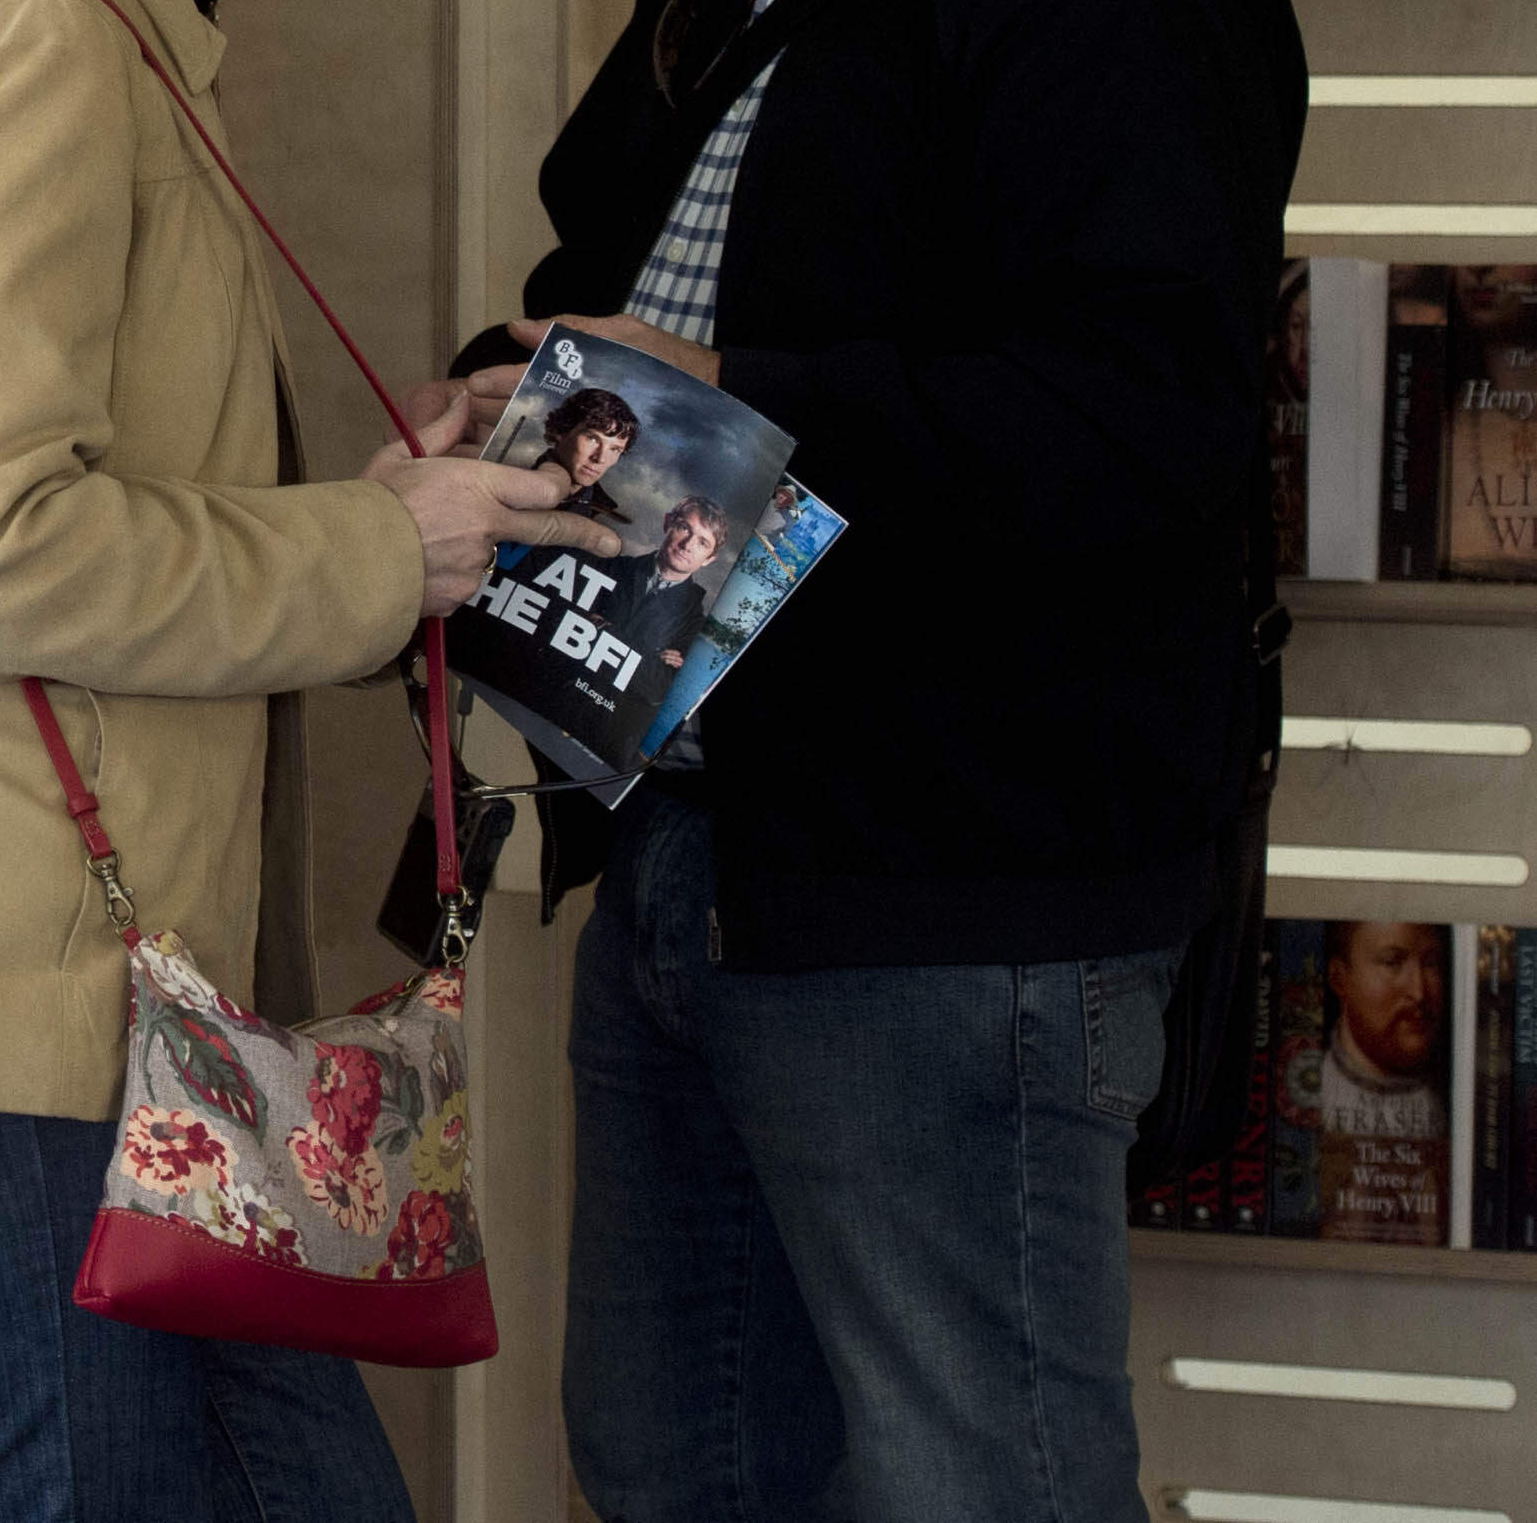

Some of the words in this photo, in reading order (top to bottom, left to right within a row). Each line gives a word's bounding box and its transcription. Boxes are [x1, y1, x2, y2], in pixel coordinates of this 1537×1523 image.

[541, 370, 572, 391] Film
[532, 553, 617, 613] AT
[467, 572, 552, 635] HE
[549, 608, 643, 693] BFI
[574, 678, 617, 713] bfi.org.uk
